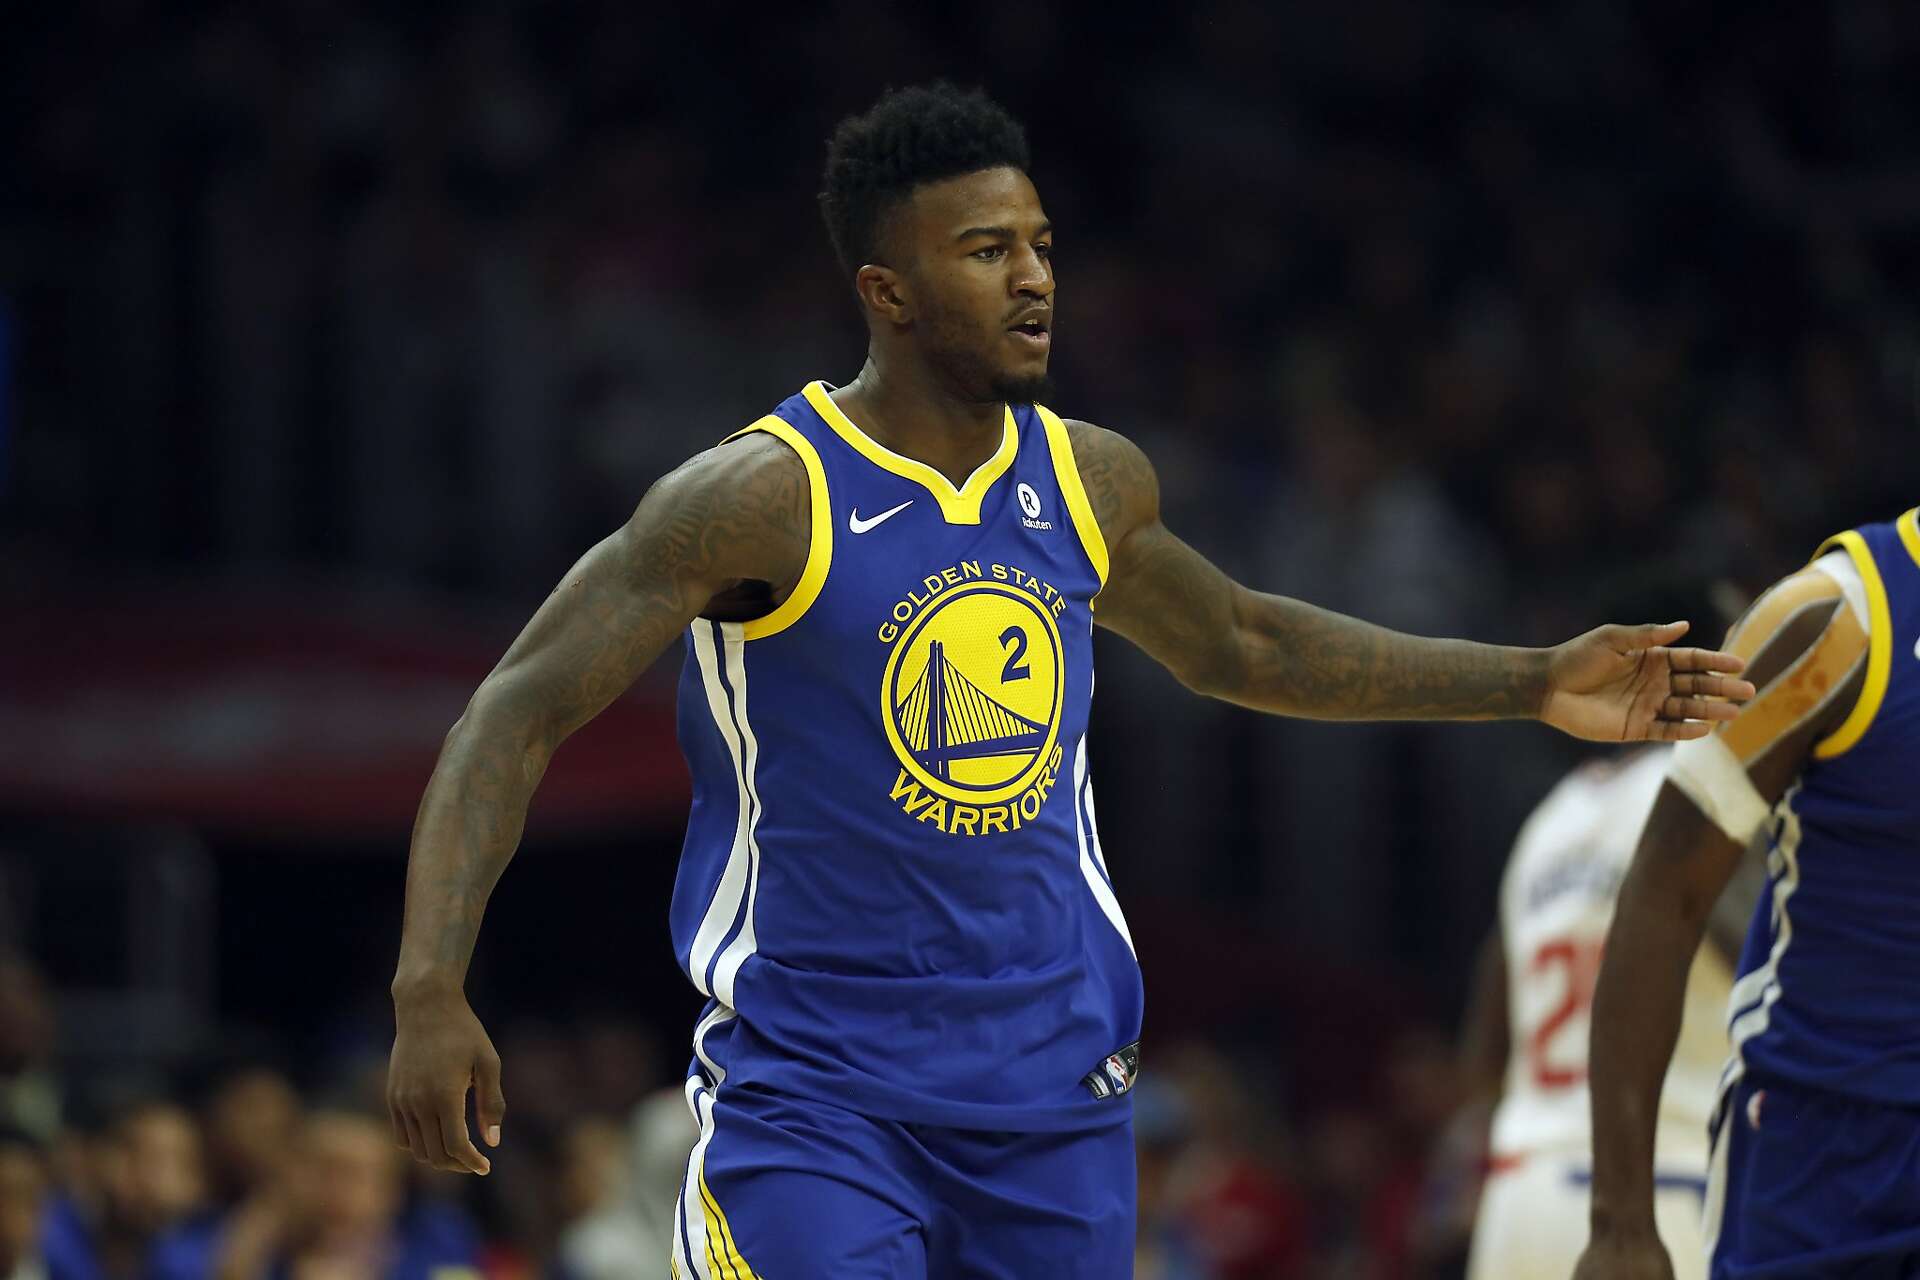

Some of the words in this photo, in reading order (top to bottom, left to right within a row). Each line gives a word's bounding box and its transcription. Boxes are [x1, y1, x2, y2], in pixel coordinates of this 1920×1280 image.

[1021, 516, 1053, 530] Rakuten
[878, 560, 983, 643] GOLDEN
[991, 563, 1067, 619] STATE
[998, 625, 1032, 685] 2
[888, 741, 1064, 836] WARRIORS
[1530, 940, 1605, 1090] 2
